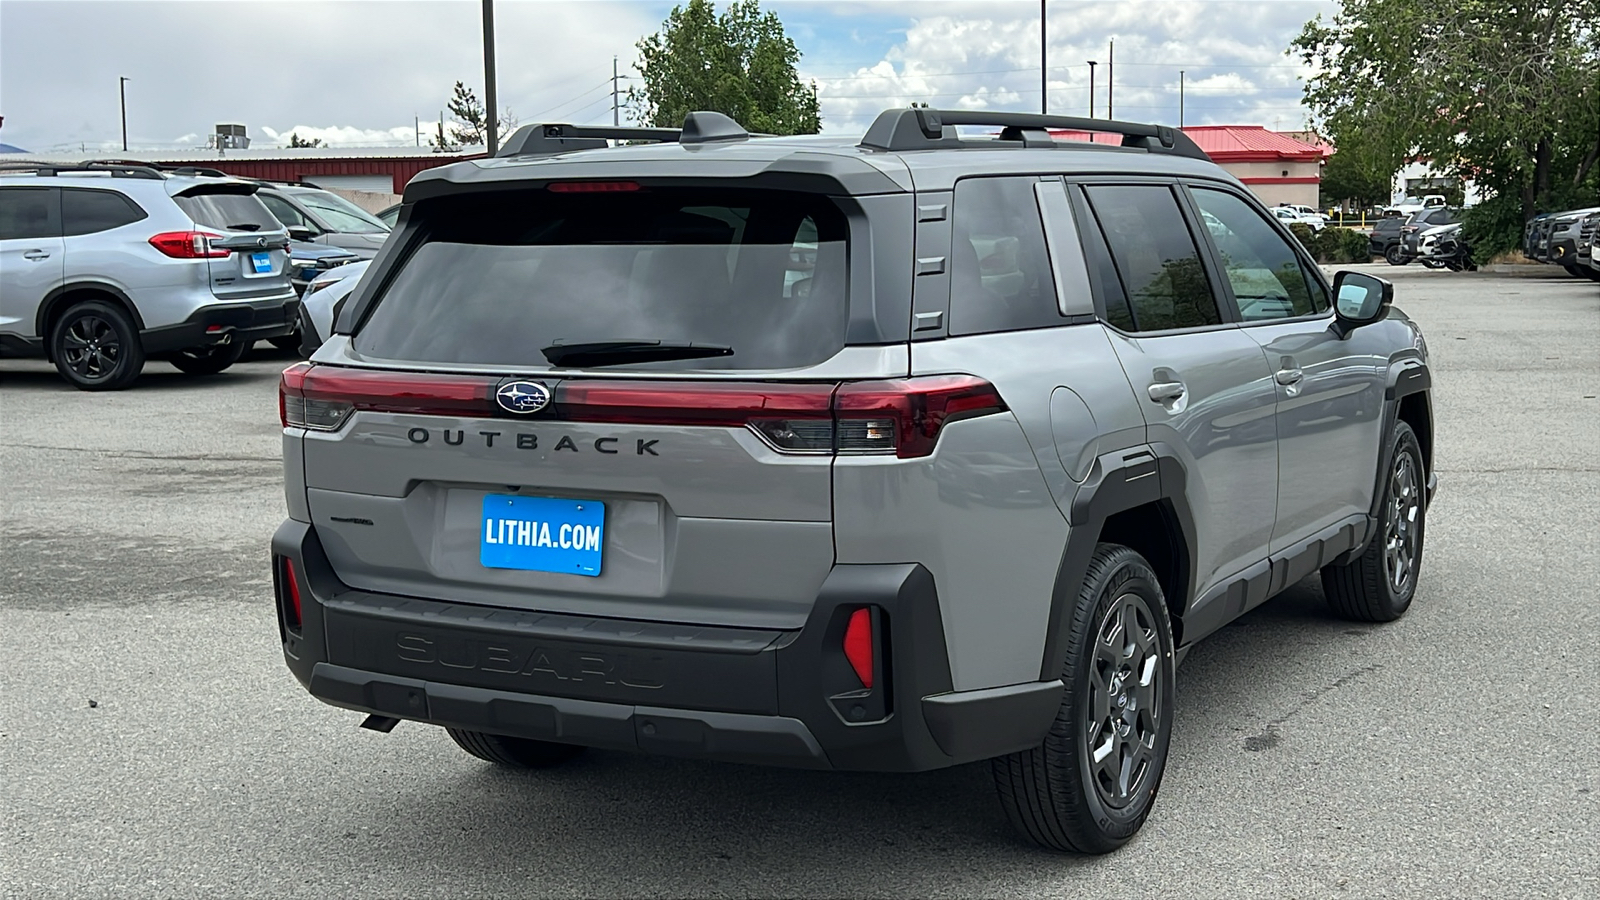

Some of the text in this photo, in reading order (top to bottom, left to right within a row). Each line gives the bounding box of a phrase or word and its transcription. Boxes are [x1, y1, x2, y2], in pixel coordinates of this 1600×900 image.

[407, 427, 660, 456] OUTBACK
[485, 518, 600, 552] LITHIA.COM
[396, 628, 666, 689] SUBARU
